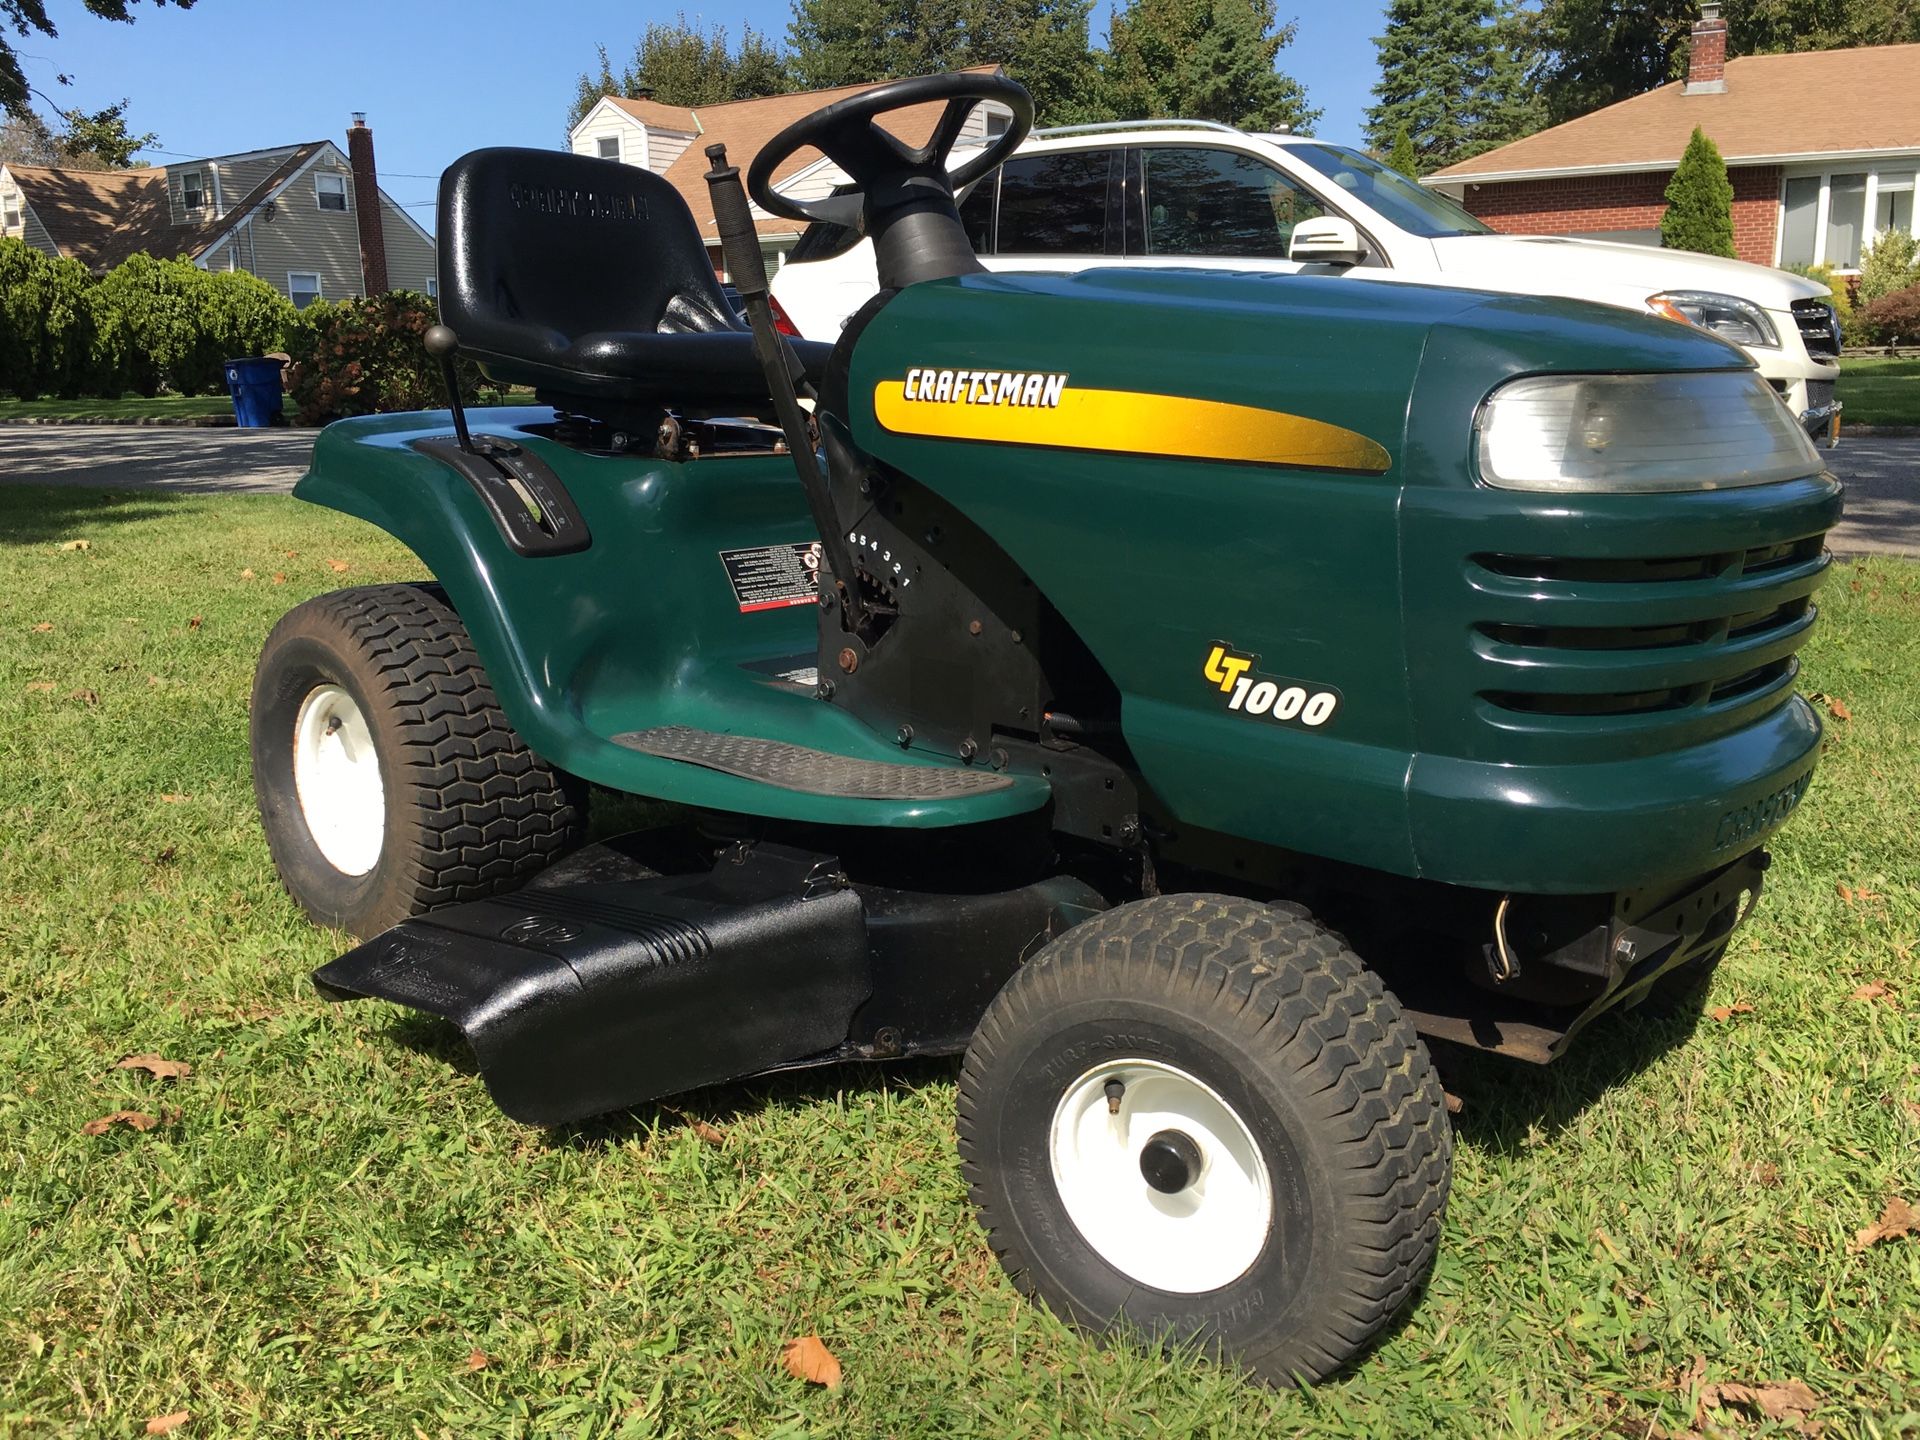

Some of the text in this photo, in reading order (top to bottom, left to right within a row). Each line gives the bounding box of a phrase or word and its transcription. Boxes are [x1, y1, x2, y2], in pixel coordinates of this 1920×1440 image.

[904, 368, 1069, 408] CRAFTSMAN
[849, 532, 911, 587] 6 5 4 3 2 1
[1204, 646, 1337, 726] LT 1000
